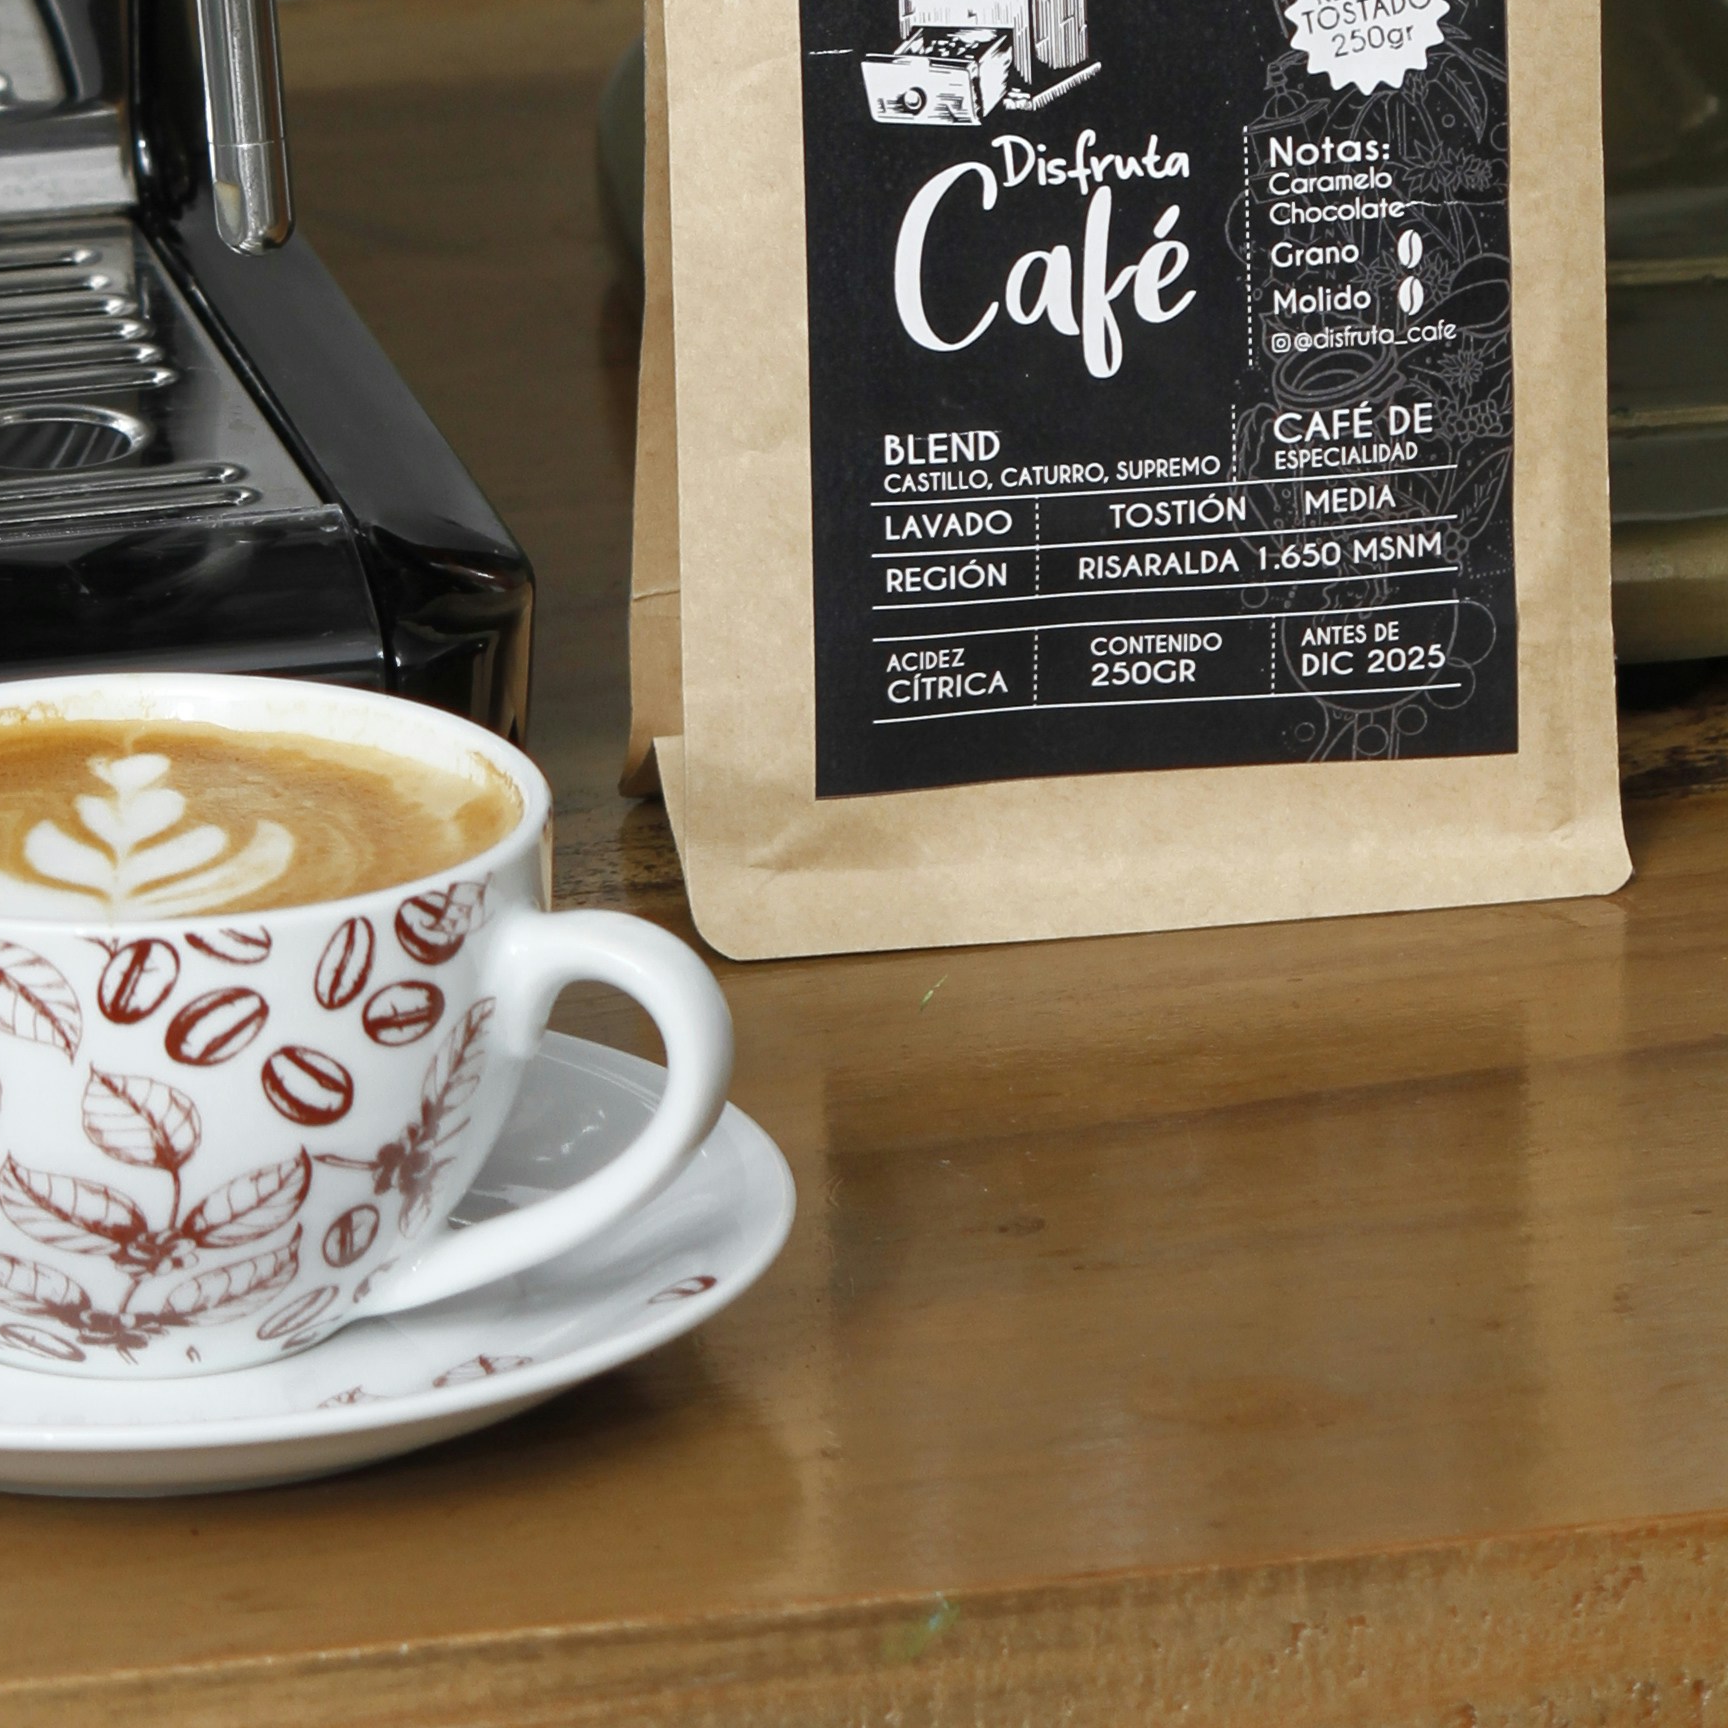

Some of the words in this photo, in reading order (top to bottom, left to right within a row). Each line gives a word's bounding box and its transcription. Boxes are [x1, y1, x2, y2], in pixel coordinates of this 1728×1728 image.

[1332, 25, 1414, 58] 250gr
[991, 129, 1190, 195] Disfruta
[1269, 136, 1390, 167] Notas:
[1269, 166, 1392, 195] Caramelo
[1269, 197, 1405, 225] Chocolate
[894, 161, 1196, 378] Café
[1271, 242, 1360, 268] Grano
[1273, 284, 1371, 314] Molido
[1294, 320, 1457, 352] @disfruta_cafe
[1273, 401, 1373, 444] CAFÉ
[1389, 402, 1433, 436] DE
[884, 431, 1001, 466] BLEND
[1275, 442, 1419, 470] ESPECIALIDAD
[884, 469, 993, 493] CASTILLO,
[1001, 462, 1109, 488] CATURRO,
[1116, 455, 1221, 481] SUPREMO
[1109, 493, 1247, 529] TOSTIÓN
[1305, 484, 1396, 515] MEDIA
[885, 510, 1013, 541] LAVADO
[1078, 549, 1239, 581] RISARALDA
[1259, 542, 1342, 571] 1.650
[1353, 532, 1442, 564] MSNM
[886, 559, 1007, 593] REGIÓN
[1090, 632, 1223, 657] CONTENIDO
[1301, 623, 1369, 647] ANTES
[1373, 621, 1400, 642] DE
[886, 647, 965, 672] ACIDEZ
[1090, 659, 1197, 687] 250GR
[1301, 650, 1355, 678] DIC
[1367, 644, 1447, 674] 2025
[886, 671, 1008, 705] CÍTRICA
